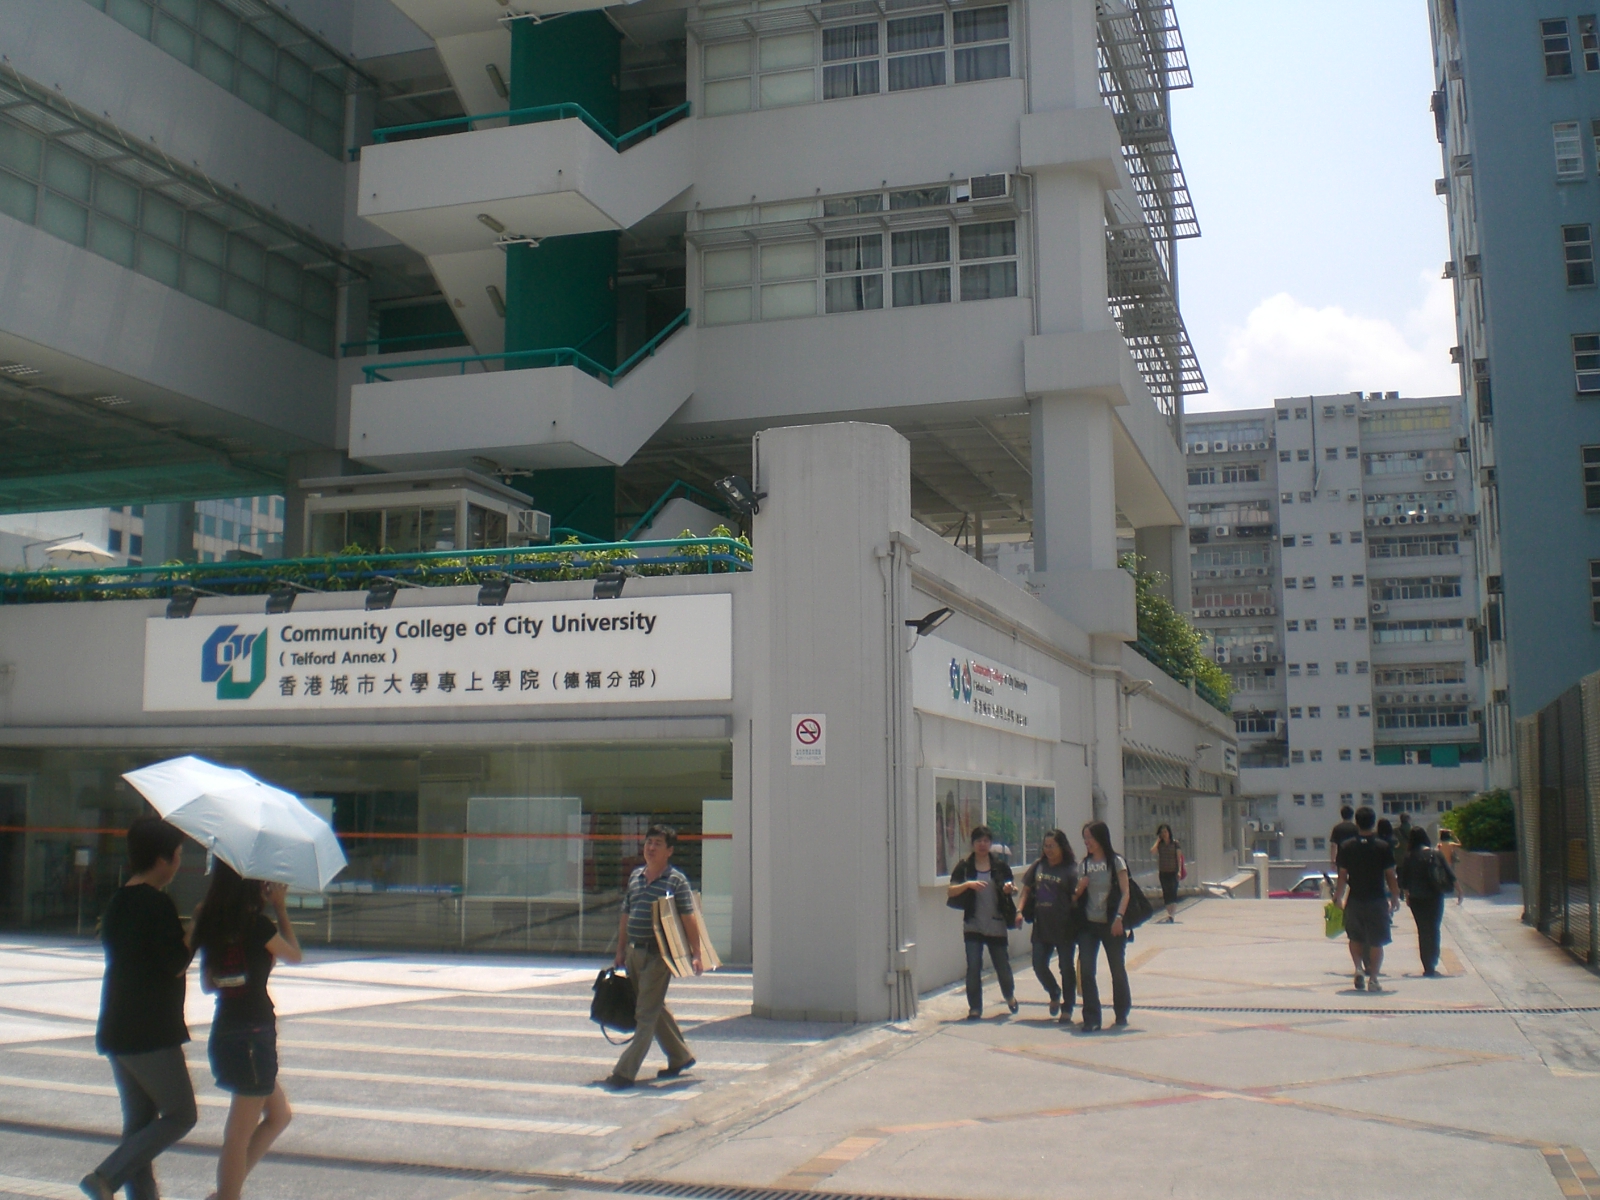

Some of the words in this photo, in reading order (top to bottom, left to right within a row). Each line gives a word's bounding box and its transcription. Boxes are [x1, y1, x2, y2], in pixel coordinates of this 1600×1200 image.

[280, 622, 388, 644] Community
[395, 619, 467, 642] College
[475, 616, 497, 636] of
[504, 616, 544, 639] City
[552, 611, 657, 635] University
